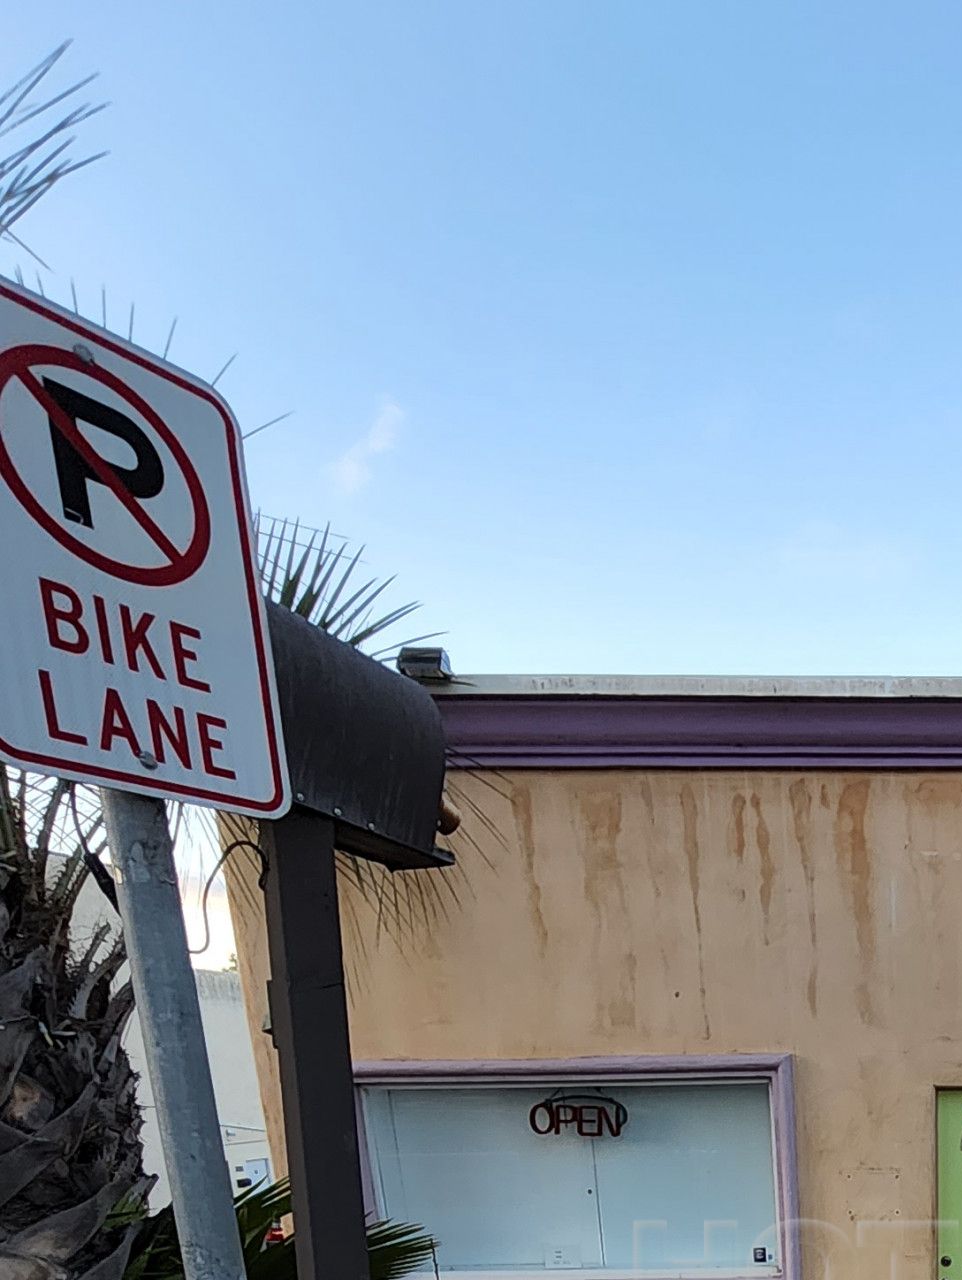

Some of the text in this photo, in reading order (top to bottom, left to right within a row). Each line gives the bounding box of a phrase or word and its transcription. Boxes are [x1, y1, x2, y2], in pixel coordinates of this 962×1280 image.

[38, 576, 212, 694] BIKE
[38, 669, 236, 781] LANE
[529, 1103, 621, 1137] OPEN
